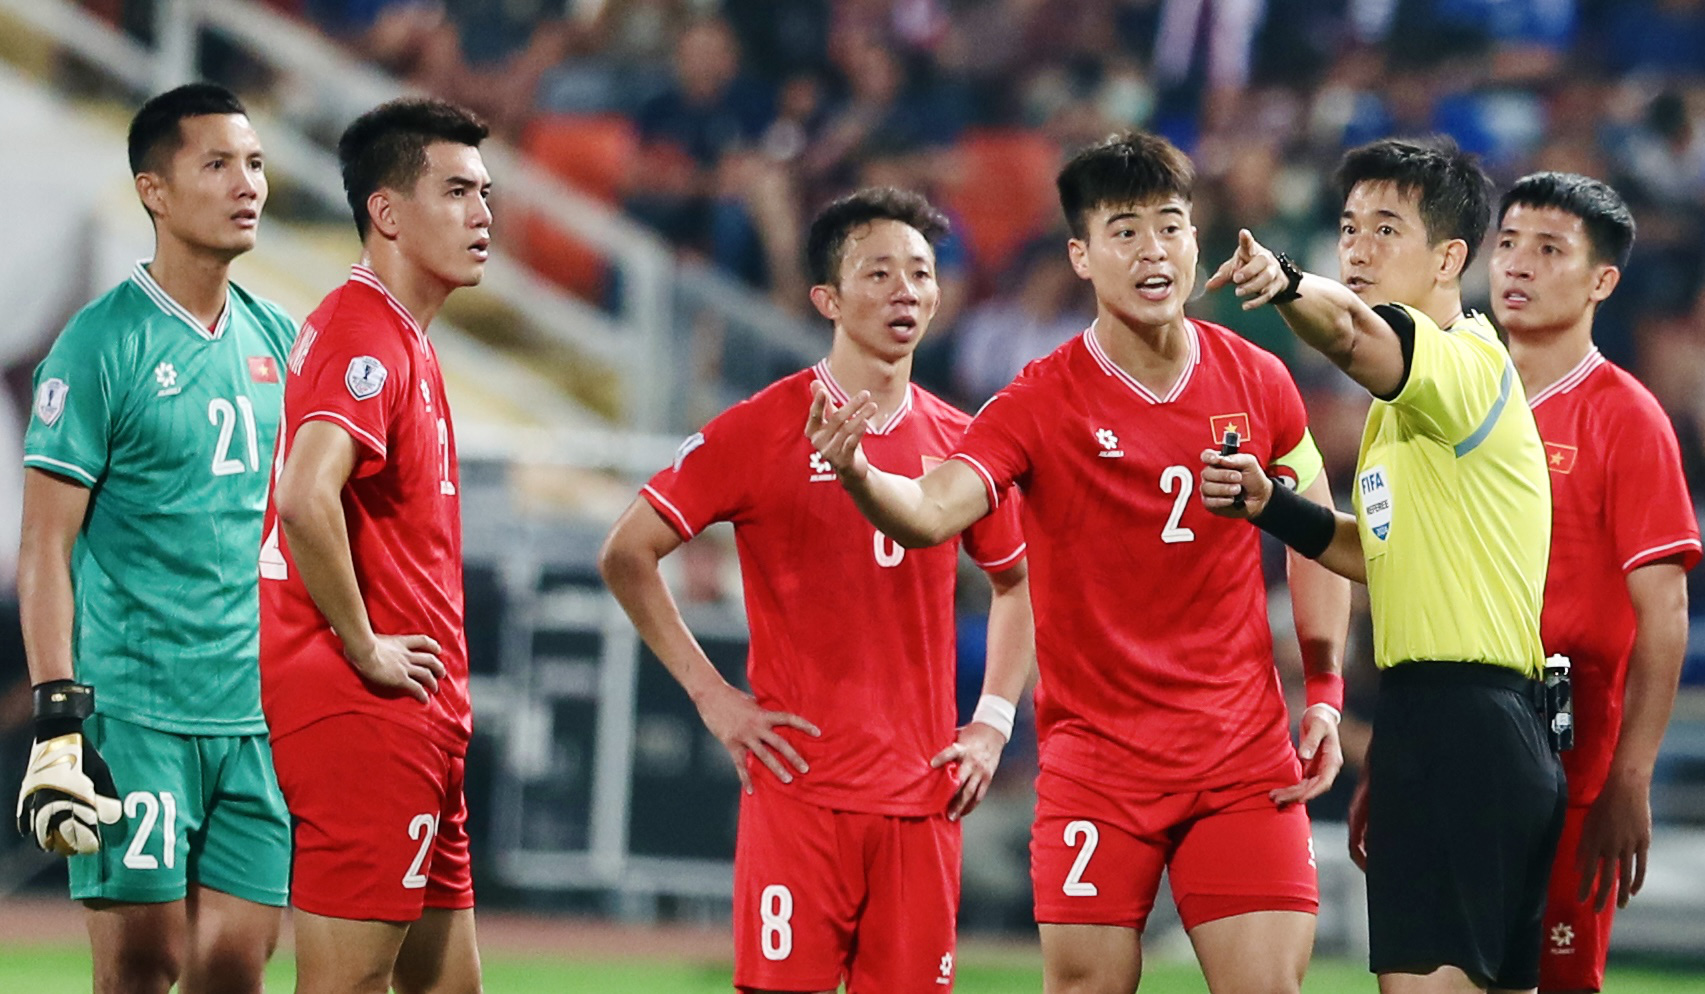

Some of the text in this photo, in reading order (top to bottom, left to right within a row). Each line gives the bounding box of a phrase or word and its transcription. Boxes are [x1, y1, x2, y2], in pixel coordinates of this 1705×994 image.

[208, 395, 260, 477] 21
[1160, 465, 1195, 544] 2
[1361, 471, 1385, 495] FIFA
[1366, 499, 1389, 515] REFEREE
[122, 791, 177, 870] 21
[1062, 820, 1099, 897] 2
[760, 884, 793, 961] 8
